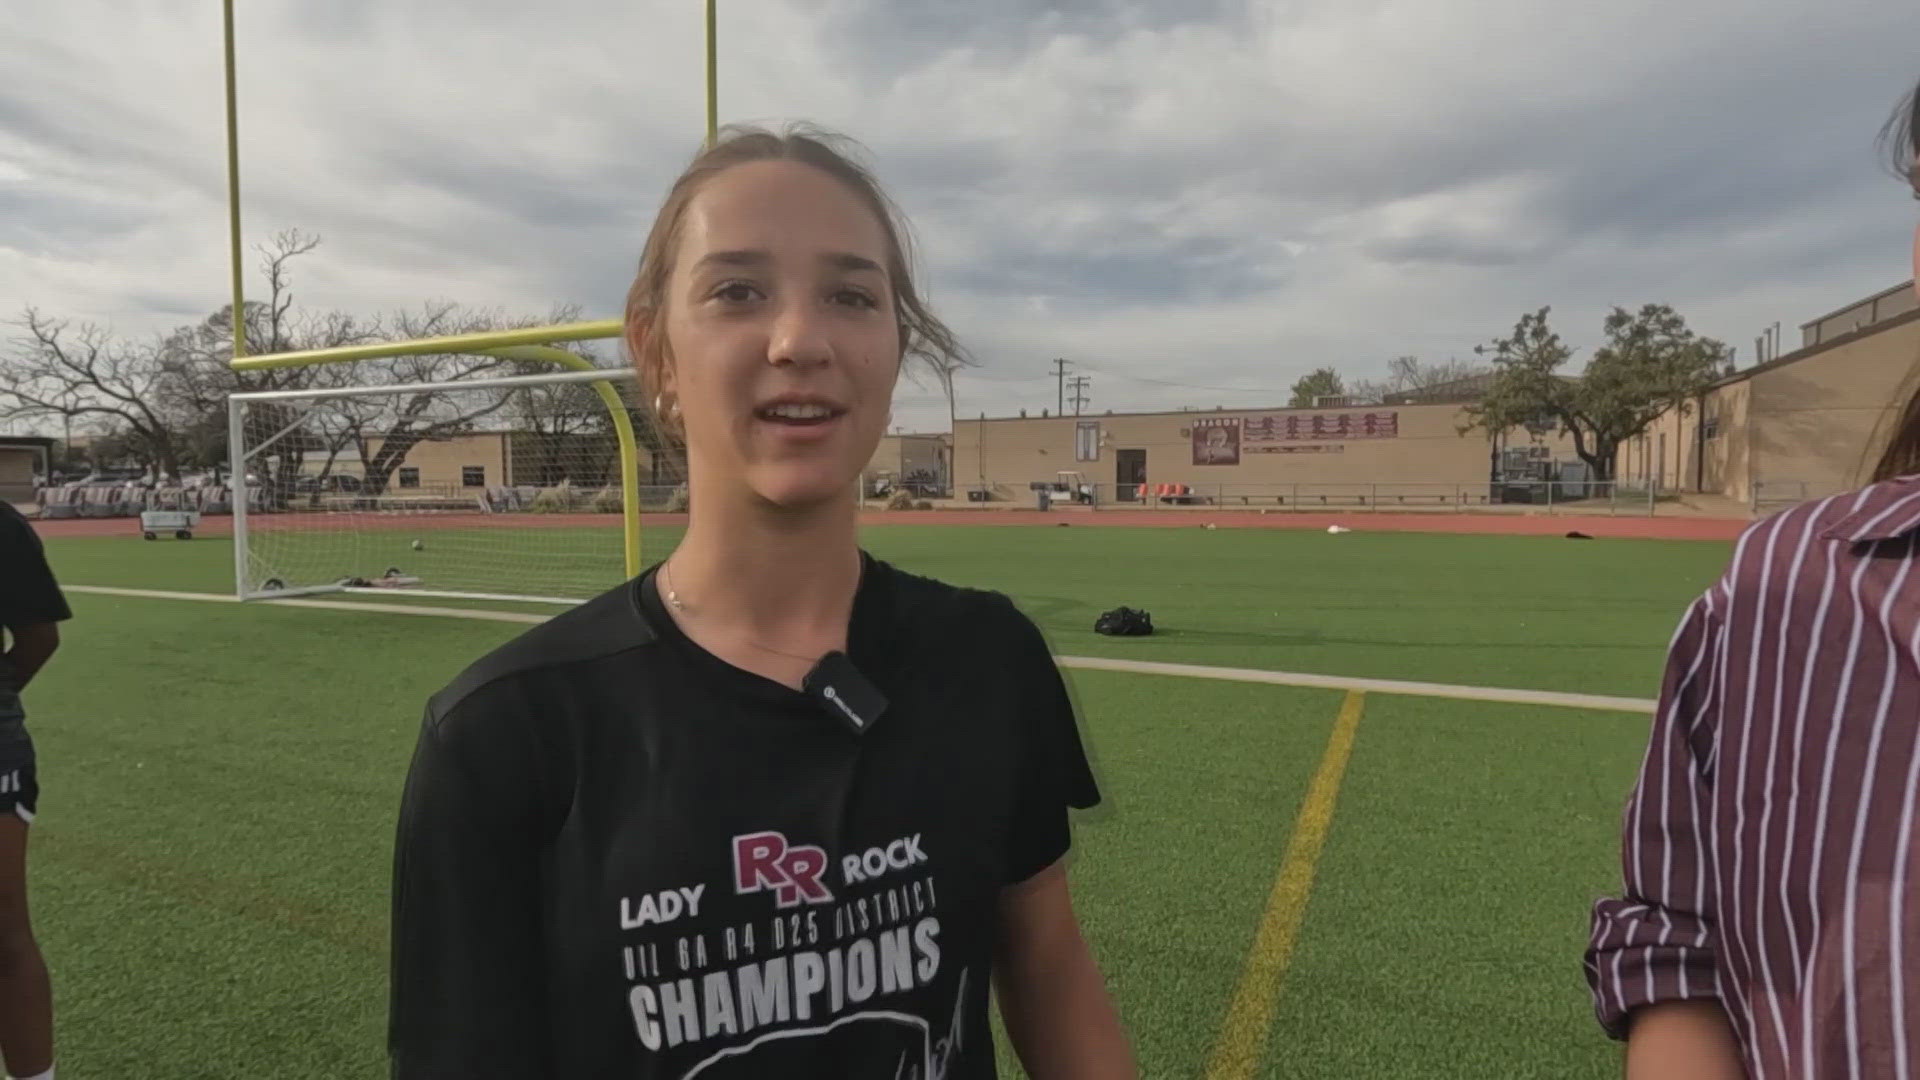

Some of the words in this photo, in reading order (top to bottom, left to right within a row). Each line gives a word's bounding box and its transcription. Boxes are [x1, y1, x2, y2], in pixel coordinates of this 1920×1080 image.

[1193, 418, 1239, 428] DRAGON
[620, 883, 707, 931] LADY
[842, 833, 928, 886] ROCK
[623, 943, 659, 980] UIL
[725, 922, 755, 960] R4
[774, 911, 818, 950] D25
[835, 876, 937, 939] DISTRICT
[628, 916, 941, 1053] CHAMPIONS
